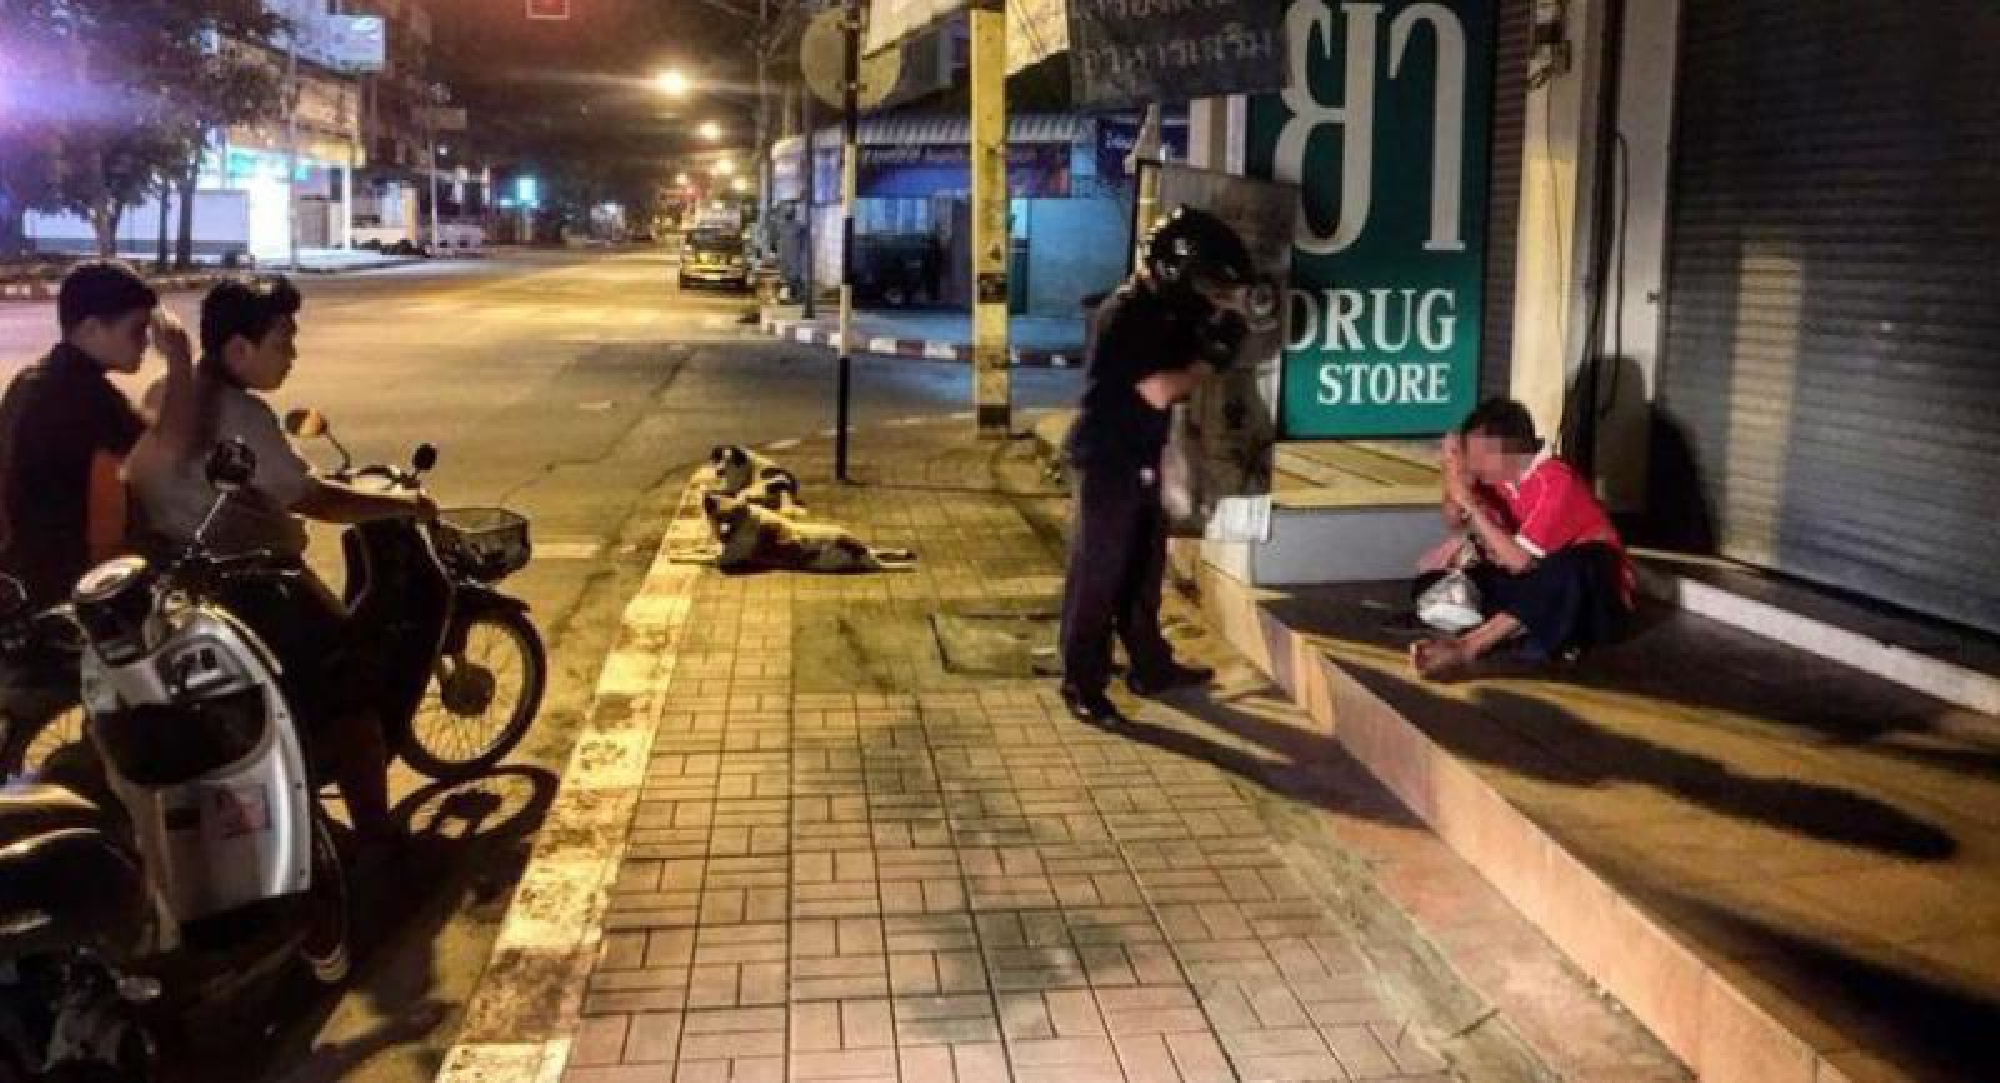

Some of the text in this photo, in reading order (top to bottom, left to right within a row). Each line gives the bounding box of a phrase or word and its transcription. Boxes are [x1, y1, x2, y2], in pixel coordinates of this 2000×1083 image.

[1274, 1, 1466, 255] ยา
[1284, 287, 1457, 353] DRUG
[1317, 362, 1451, 405] STORE
